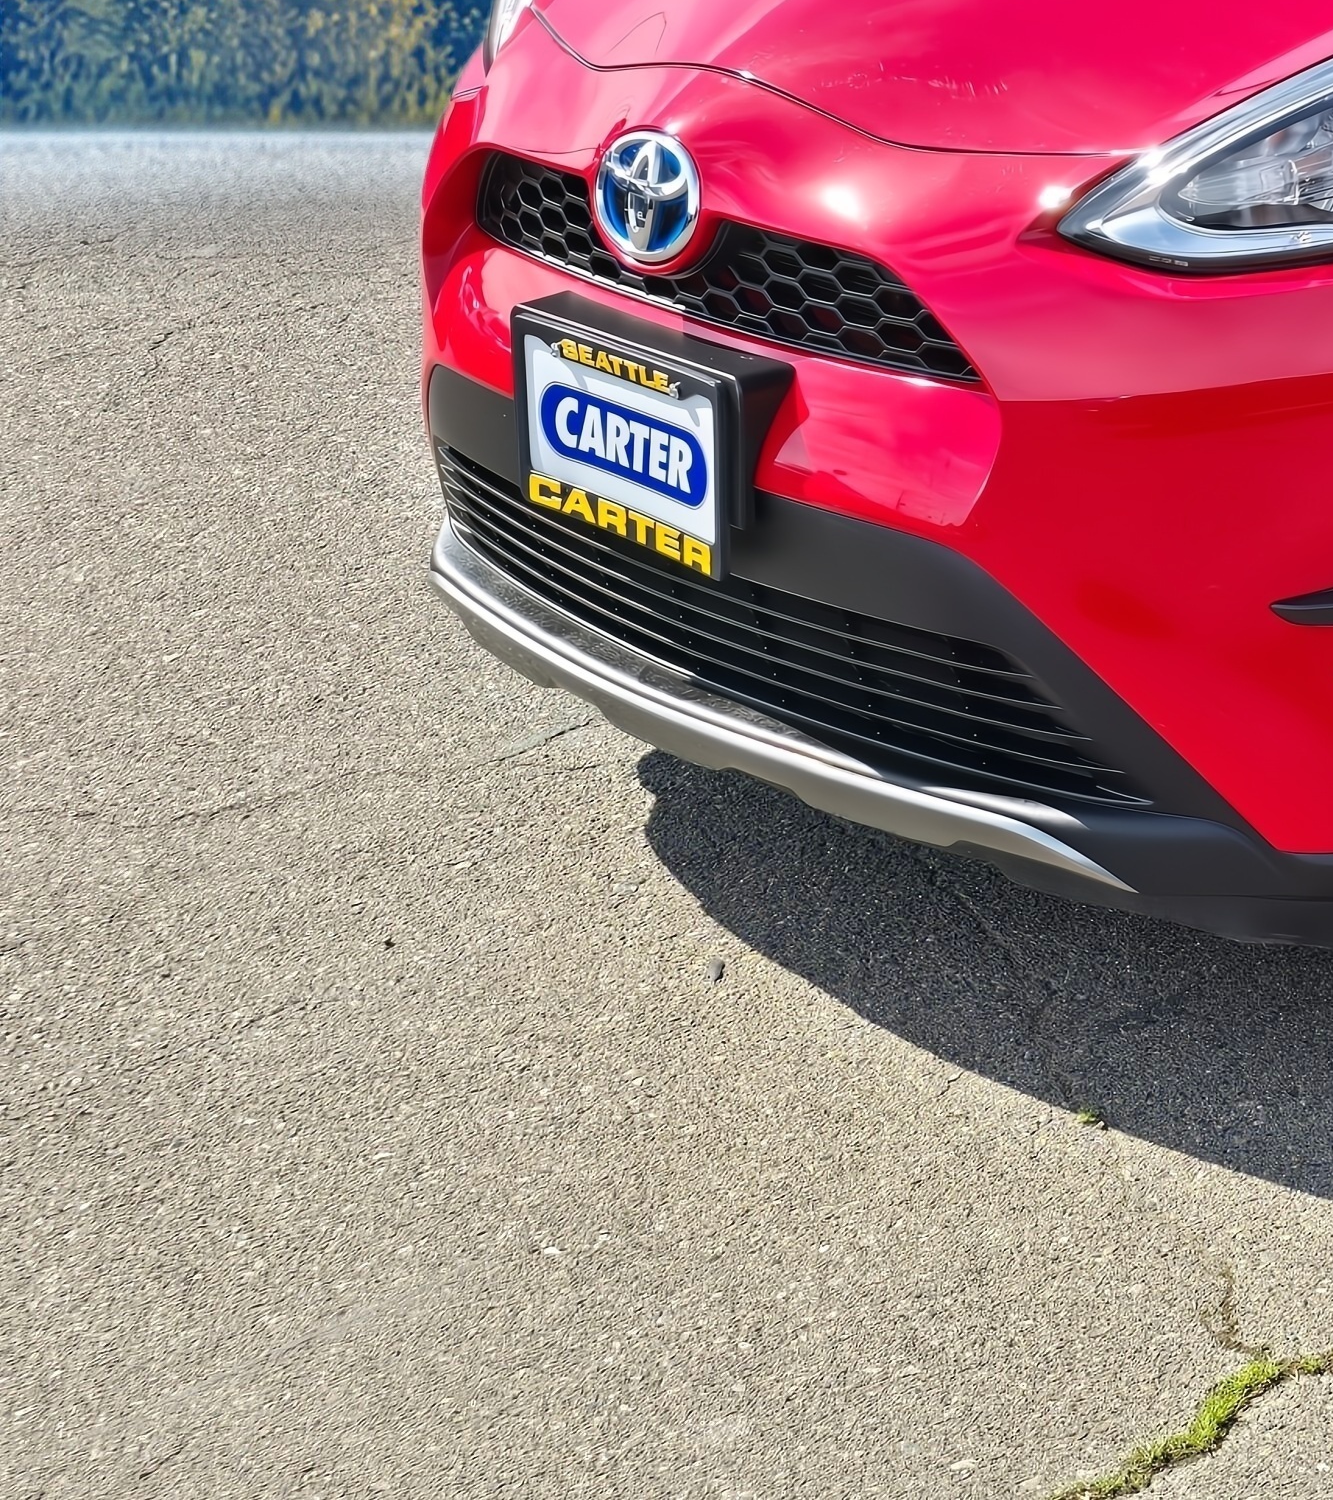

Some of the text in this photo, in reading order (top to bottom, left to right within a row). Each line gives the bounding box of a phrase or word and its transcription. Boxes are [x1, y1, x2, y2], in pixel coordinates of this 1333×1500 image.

[560, 338, 673, 393] SEATTLE
[554, 396, 693, 494] CARTER
[528, 472, 712, 576] CARTER
